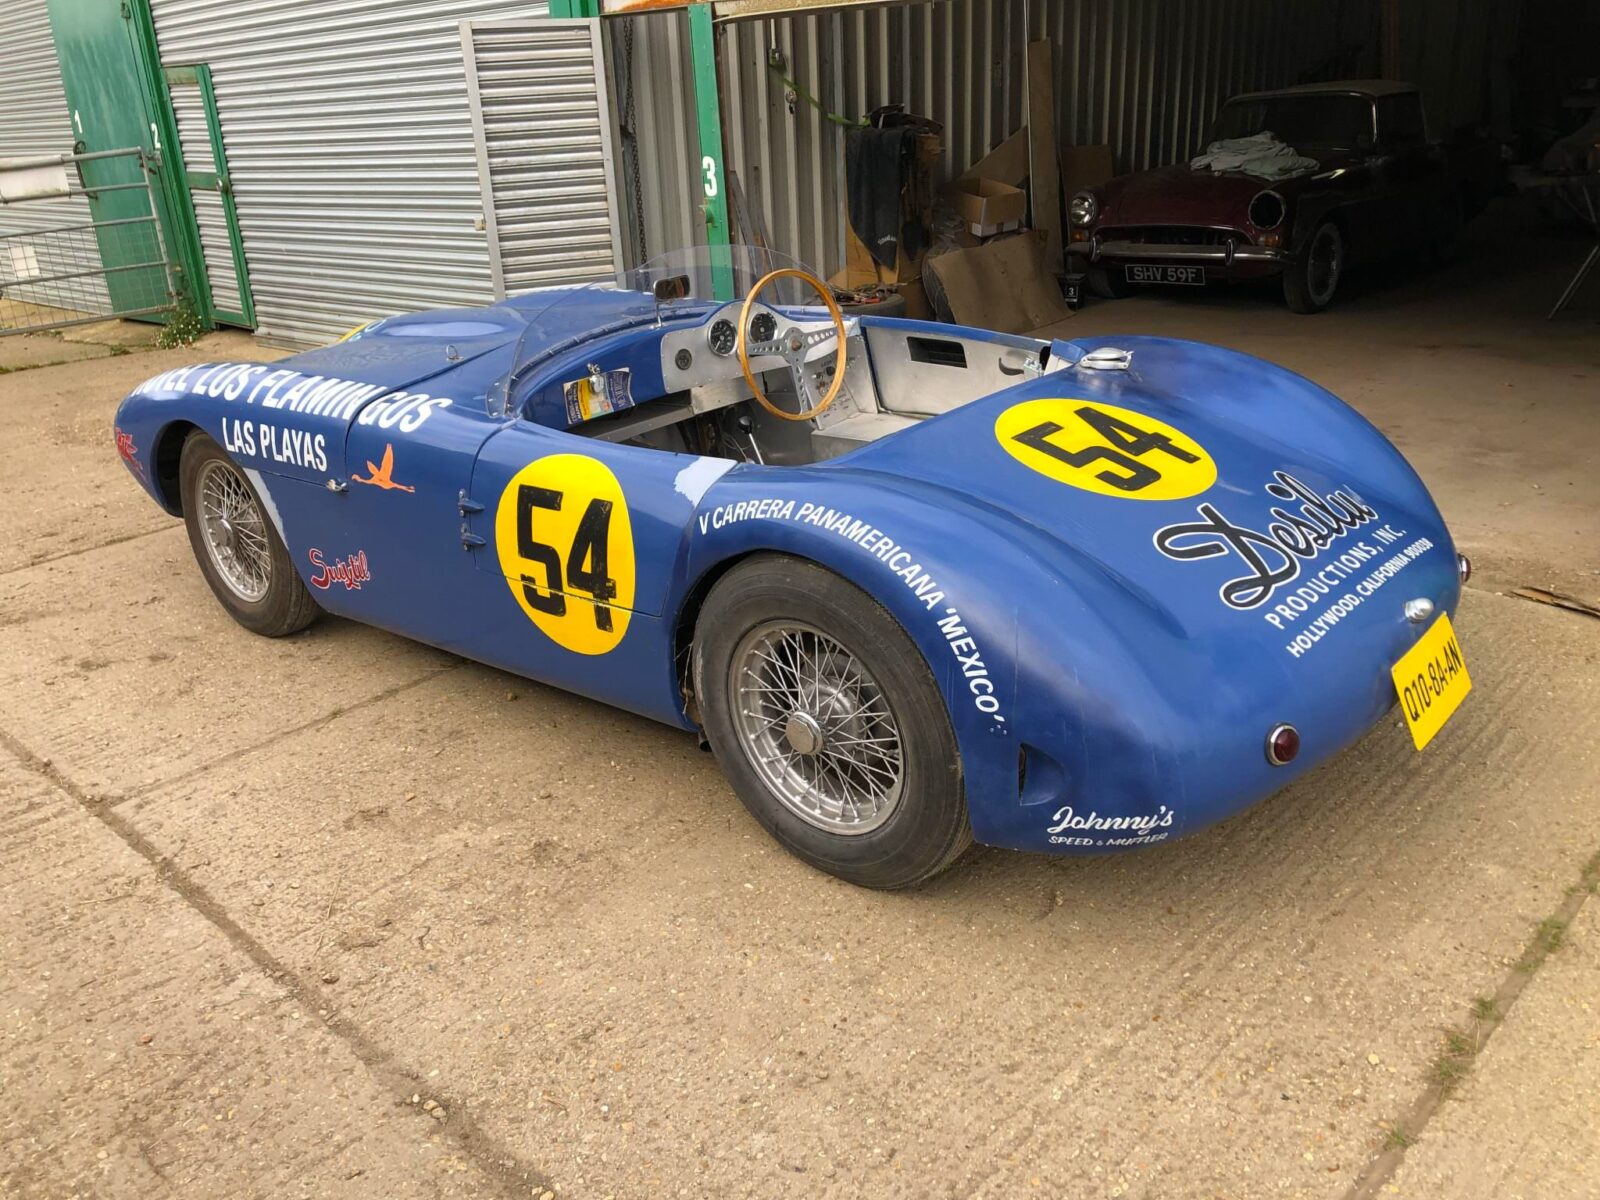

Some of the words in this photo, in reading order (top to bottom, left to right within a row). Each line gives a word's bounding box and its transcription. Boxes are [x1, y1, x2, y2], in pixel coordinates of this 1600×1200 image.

[75, 110, 83, 134] 1
[151, 123, 161, 149] 2
[702, 156, 718, 197] 3
[1133, 266, 1162, 281] SHV
[1167, 268, 1197, 282] 59F
[191, 362, 266, 401] LOS
[246, 369, 453, 433] FLAMINGOS
[222, 416, 257, 457] LAS
[259, 423, 327, 472] PLAYAS
[1010, 406, 1202, 492] 54
[516, 483, 617, 633] 54
[699, 512, 710, 536] V
[712, 499, 796, 530] CARRERA
[794, 502, 945, 611] PANAMERICANA
[1152, 470, 1379, 611] Desilu
[1264, 541, 1385, 630] PRODUCTIONS,
[1286, 593, 1366, 658] HOLLYWOOD,
[1356, 552, 1412, 597] CALIFORNIA
[1046, 804, 1175, 836] Johnny's
[1048, 836, 1093, 846] SPEED
[1105, 832, 1169, 846] MUFFLER
